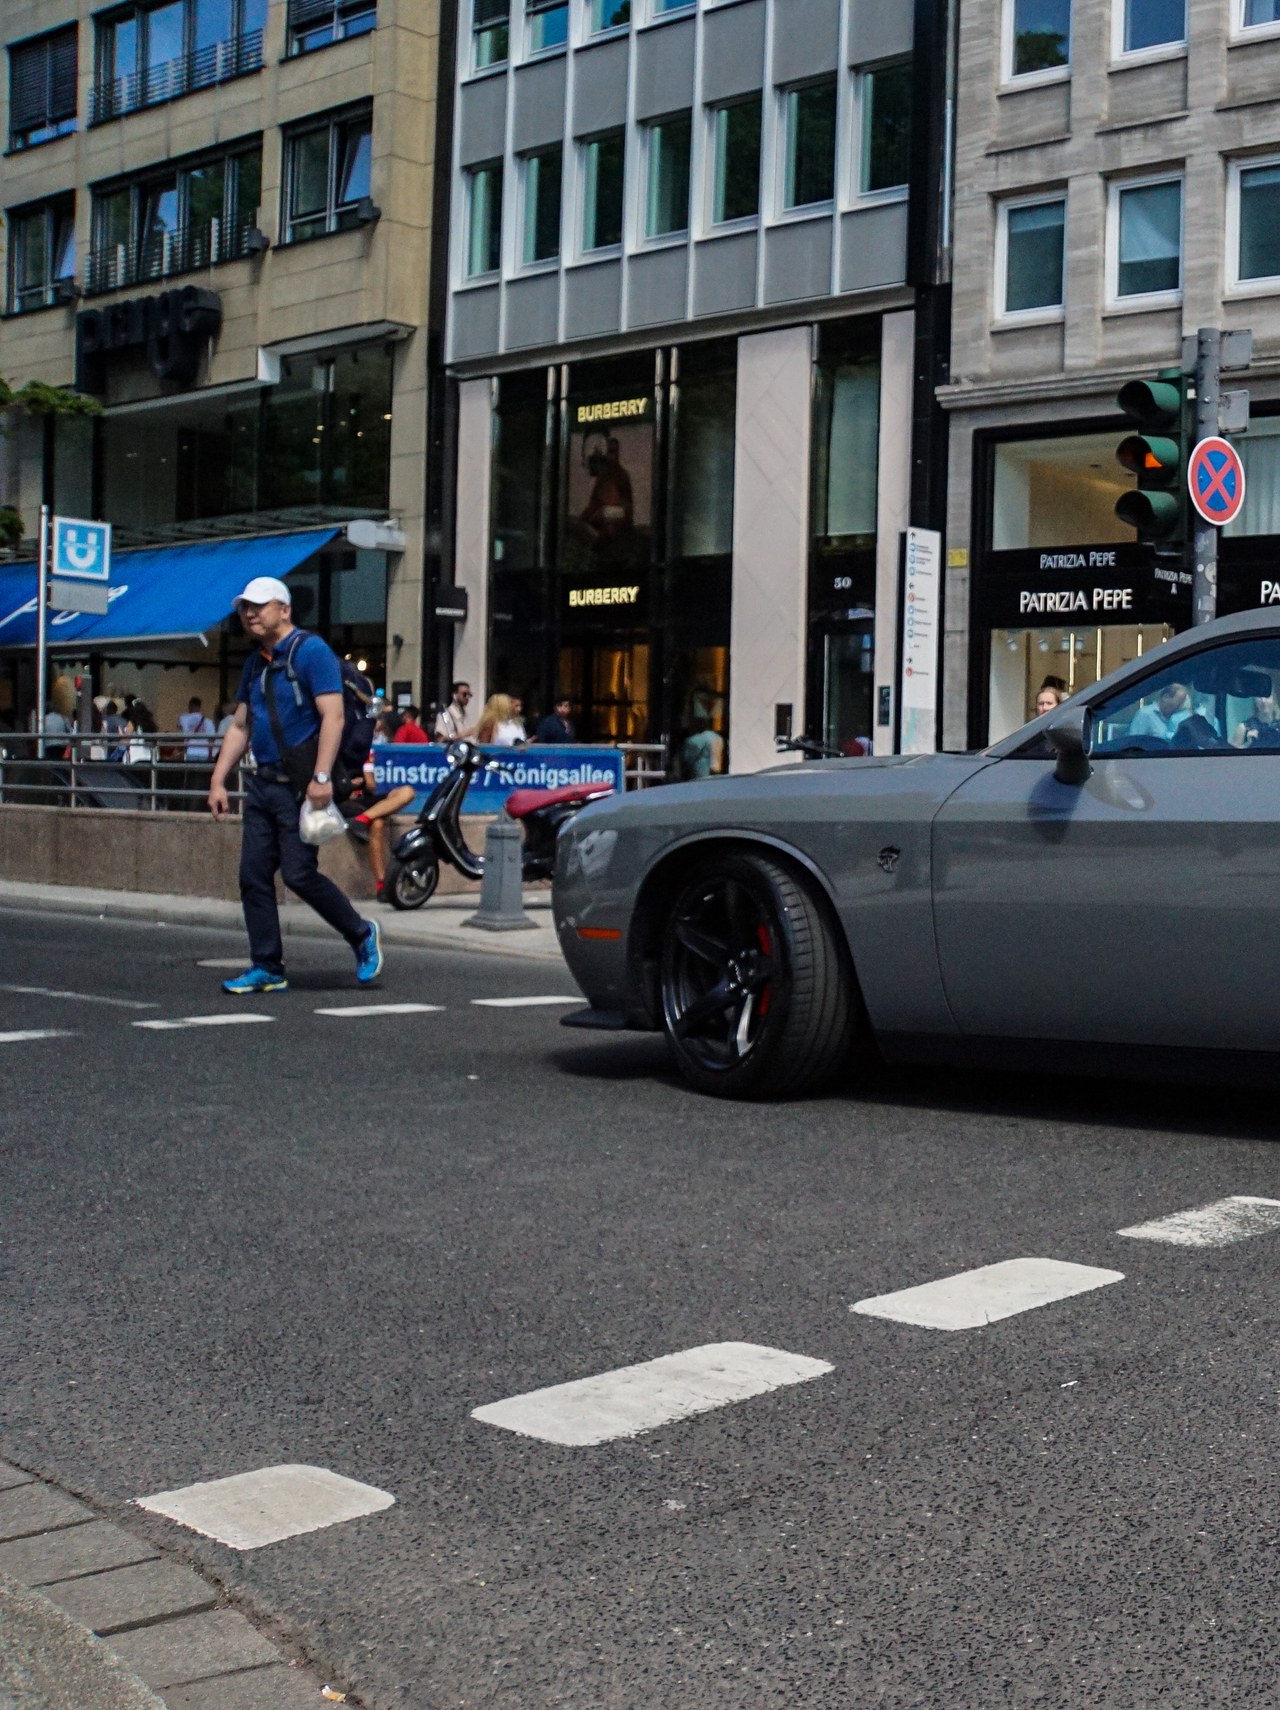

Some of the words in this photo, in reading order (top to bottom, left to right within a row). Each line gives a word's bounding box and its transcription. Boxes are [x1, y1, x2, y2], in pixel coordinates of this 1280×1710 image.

[578, 397, 648, 423] BURBERRY
[1040, 553, 1087, 570] PATRIZIA
[1089, 551, 1117, 567] PEPE
[833, 576, 852, 590] 50
[1154, 567, 1179, 582] PATRIZIA
[569, 586, 640, 607] BURBERRY
[1019, 590, 1089, 614] PATRIZIA
[1092, 588, 1133, 611] PEPE
